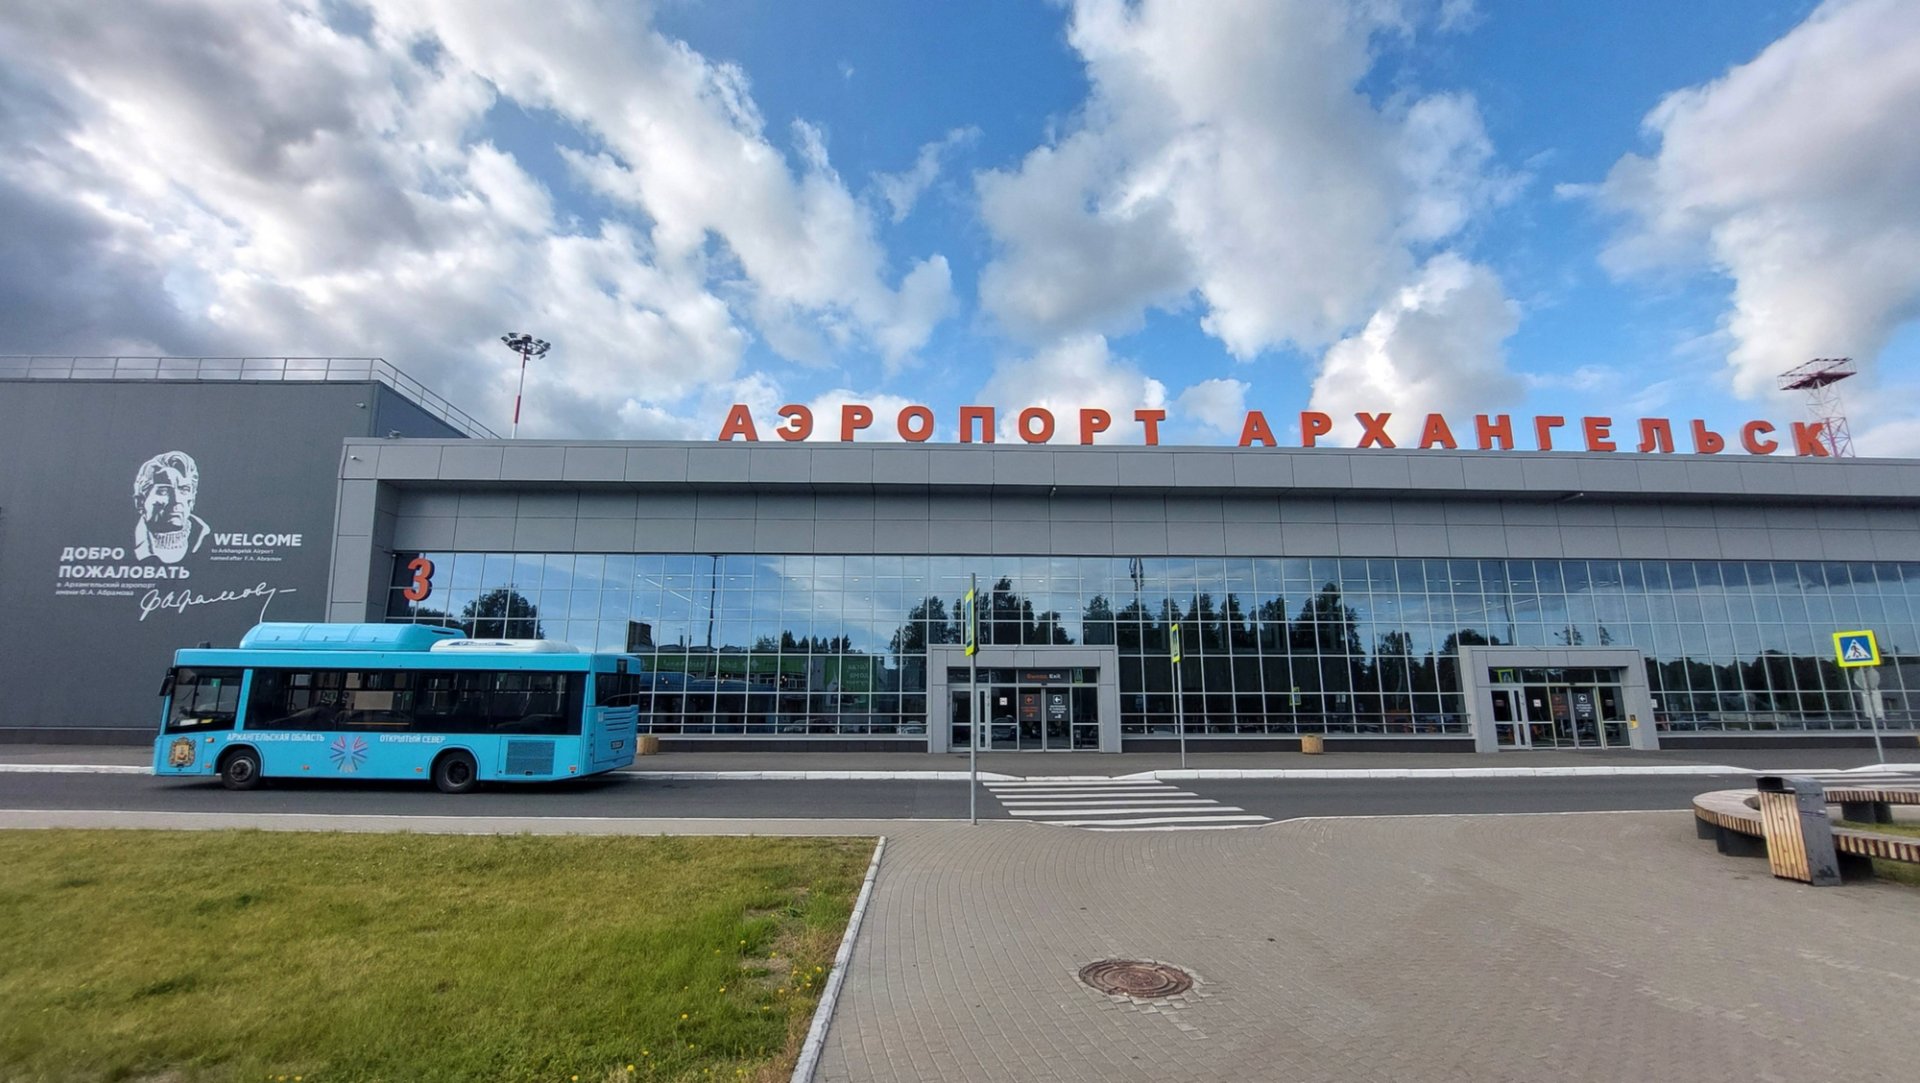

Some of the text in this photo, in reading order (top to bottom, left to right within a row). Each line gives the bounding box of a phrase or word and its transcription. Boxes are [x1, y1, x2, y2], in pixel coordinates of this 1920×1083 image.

[718, 404, 1830, 457] АЭРОПОРТ АРХАНГЕЛЬСК
[213, 532, 303, 547] WELCOME
[60, 546, 126, 562] ДОБРО
[58, 565, 190, 580] ПОЖАЛОВАТЬ
[402, 557, 435, 601] 3
[64, 581, 120, 589] Архангельский
[96, 588, 135, 597] Абрамова
[226, 732, 325, 742] АРХАНГЕЛЬСКАЯ ОБЛАСТЬ
[380, 733, 446, 744] ОТКРЫТЫЙ СЕВЕР
